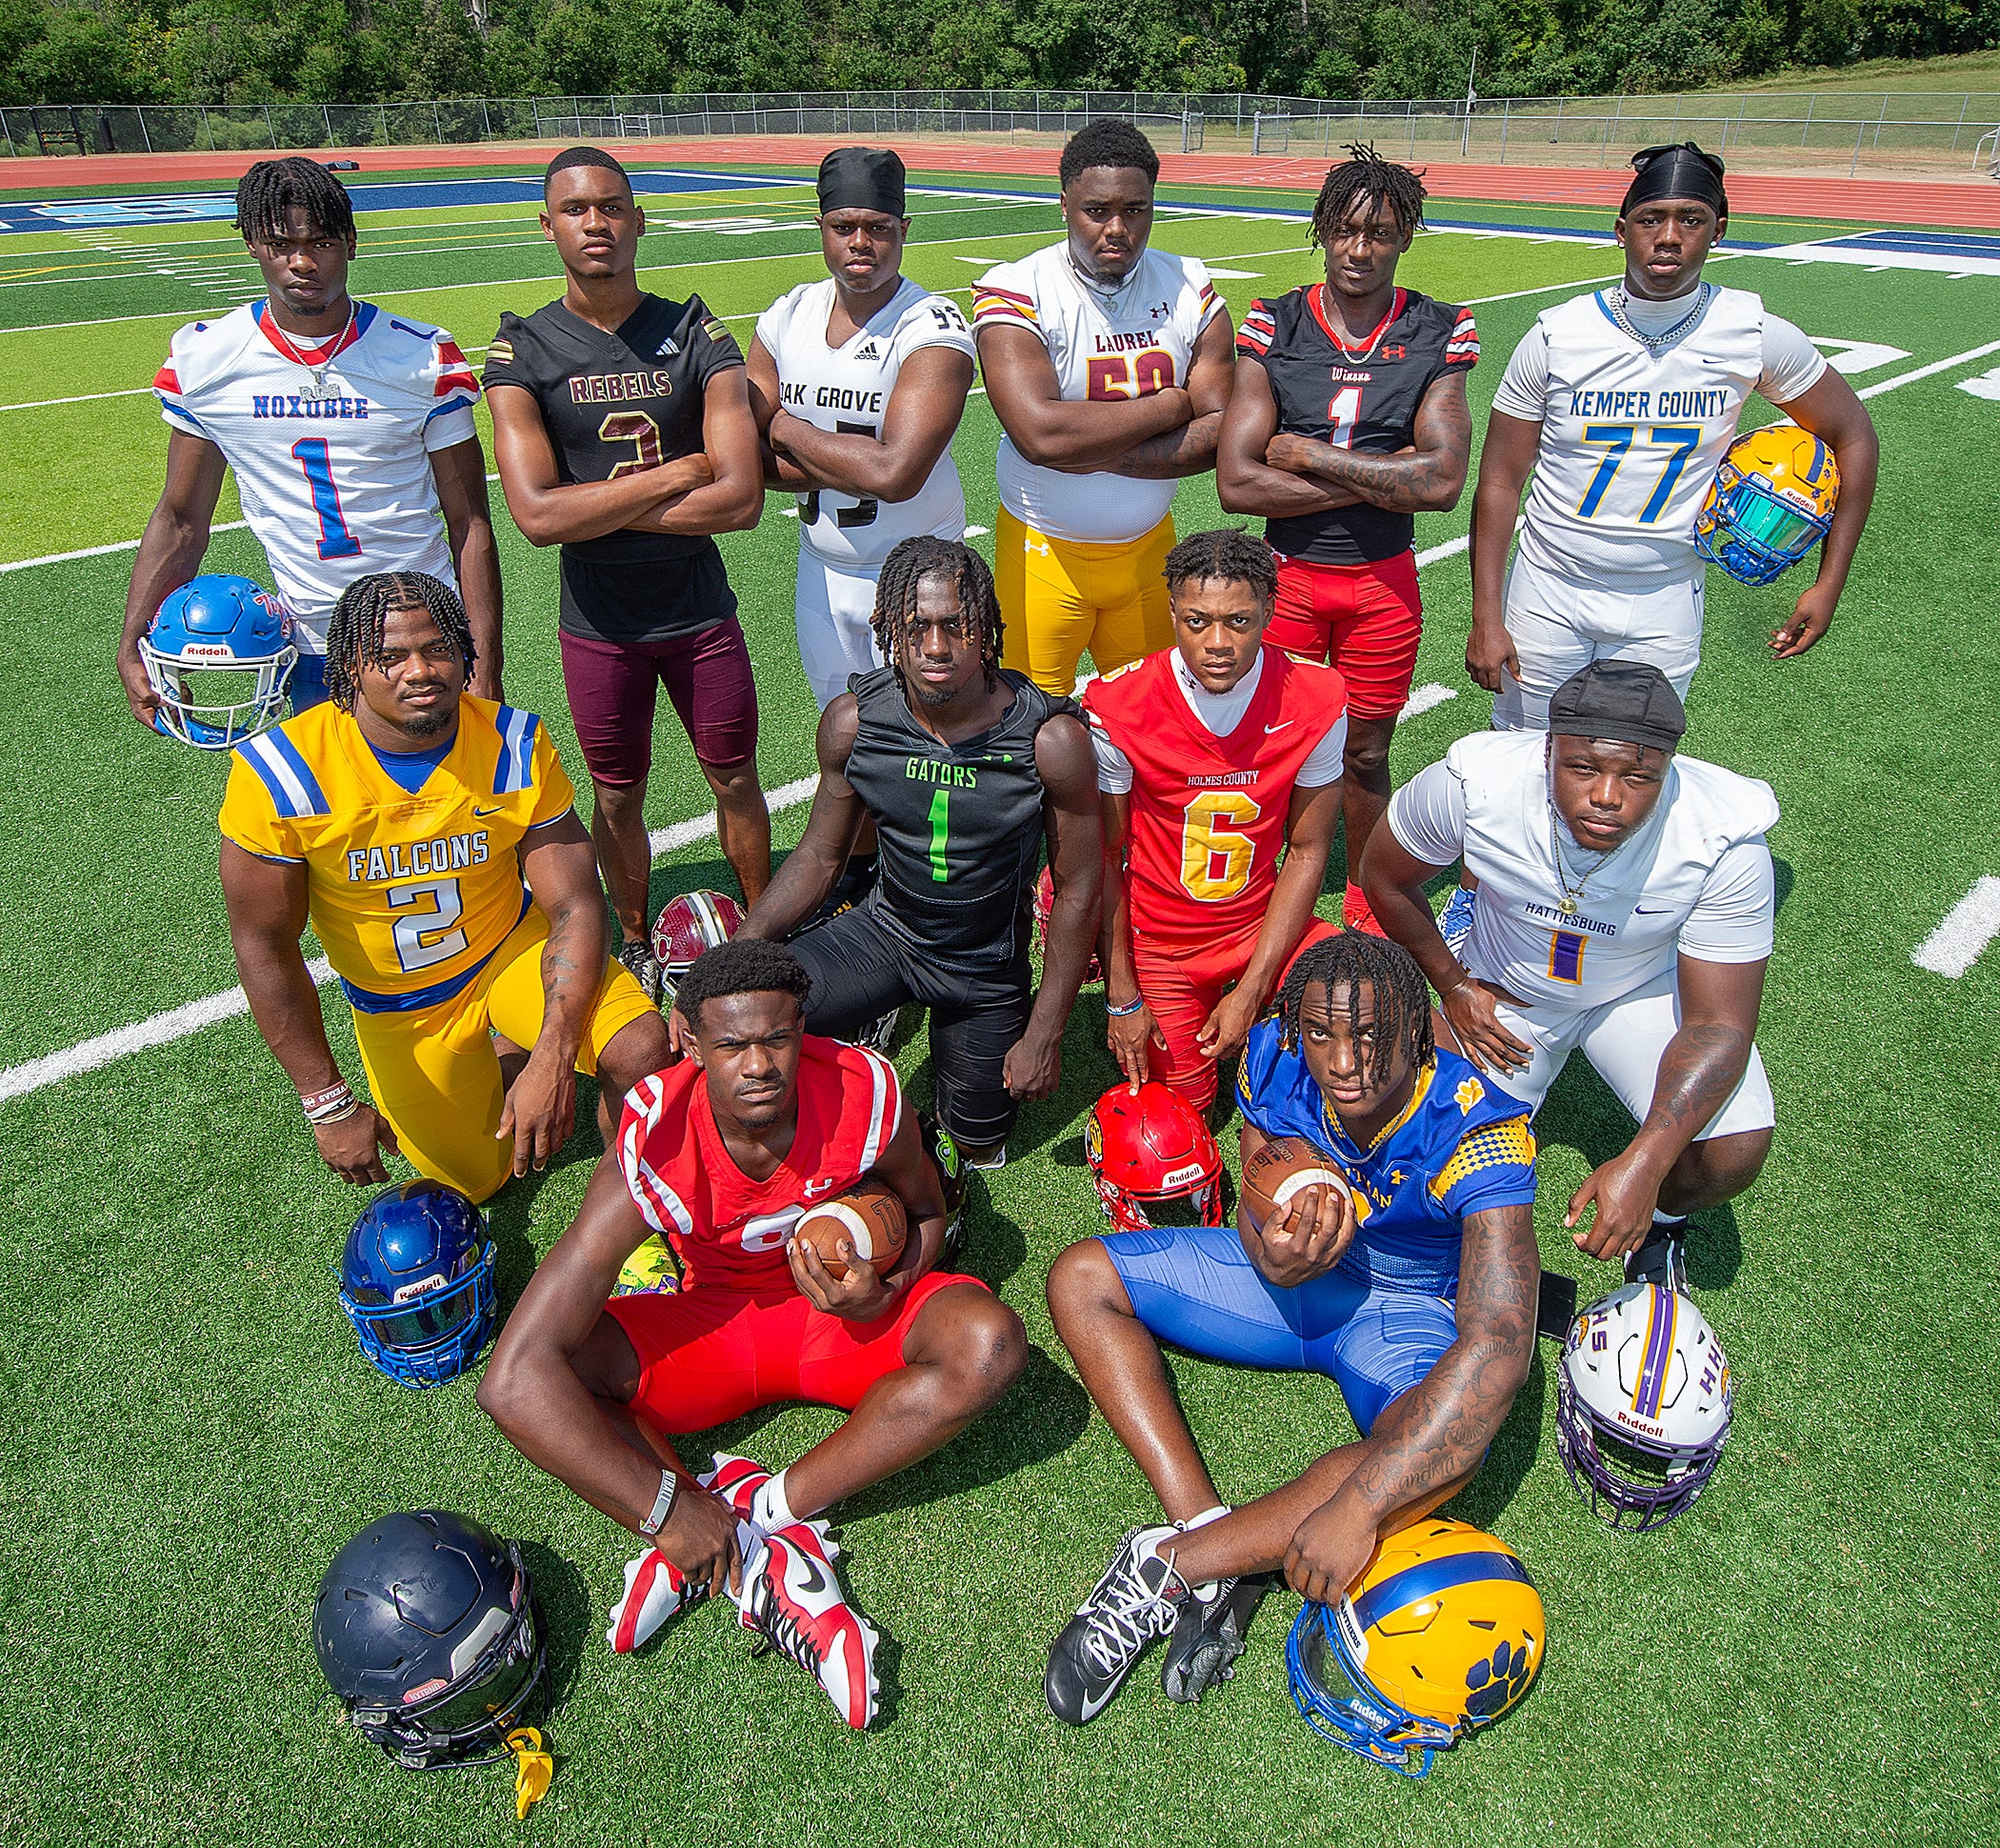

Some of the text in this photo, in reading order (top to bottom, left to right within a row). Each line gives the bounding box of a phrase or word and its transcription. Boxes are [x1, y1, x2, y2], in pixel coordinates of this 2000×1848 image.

[1095, 330, 1160, 352] LAUREL
[569, 371, 672, 404] REBELS
[1331, 366, 1372, 382] Winona
[252, 394, 369, 419] NOXUBEE
[816, 386, 883, 413] GROVE
[1570, 390, 1729, 417] KEMPER COUNTY
[1327, 386, 1363, 451] 1
[1573, 422, 1704, 527] 77
[291, 436, 363, 560] 1
[1786, 490, 1816, 512] Riddell
[187, 647, 228, 656] Riddell
[906, 756, 977, 789] GATORS
[1188, 770, 1260, 786] HOLMES COUNTY
[928, 789, 950, 882] 1
[1179, 791, 1261, 902] 6
[347, 830, 490, 881] FALCONS
[386, 876, 470, 973] 2
[1525, 901, 1617, 936] HATTIESBURG
[1168, 1166, 1201, 1185] Riddell
[399, 1278, 441, 1300] Riddell
[1617, 1411, 1664, 1438] Riddell
